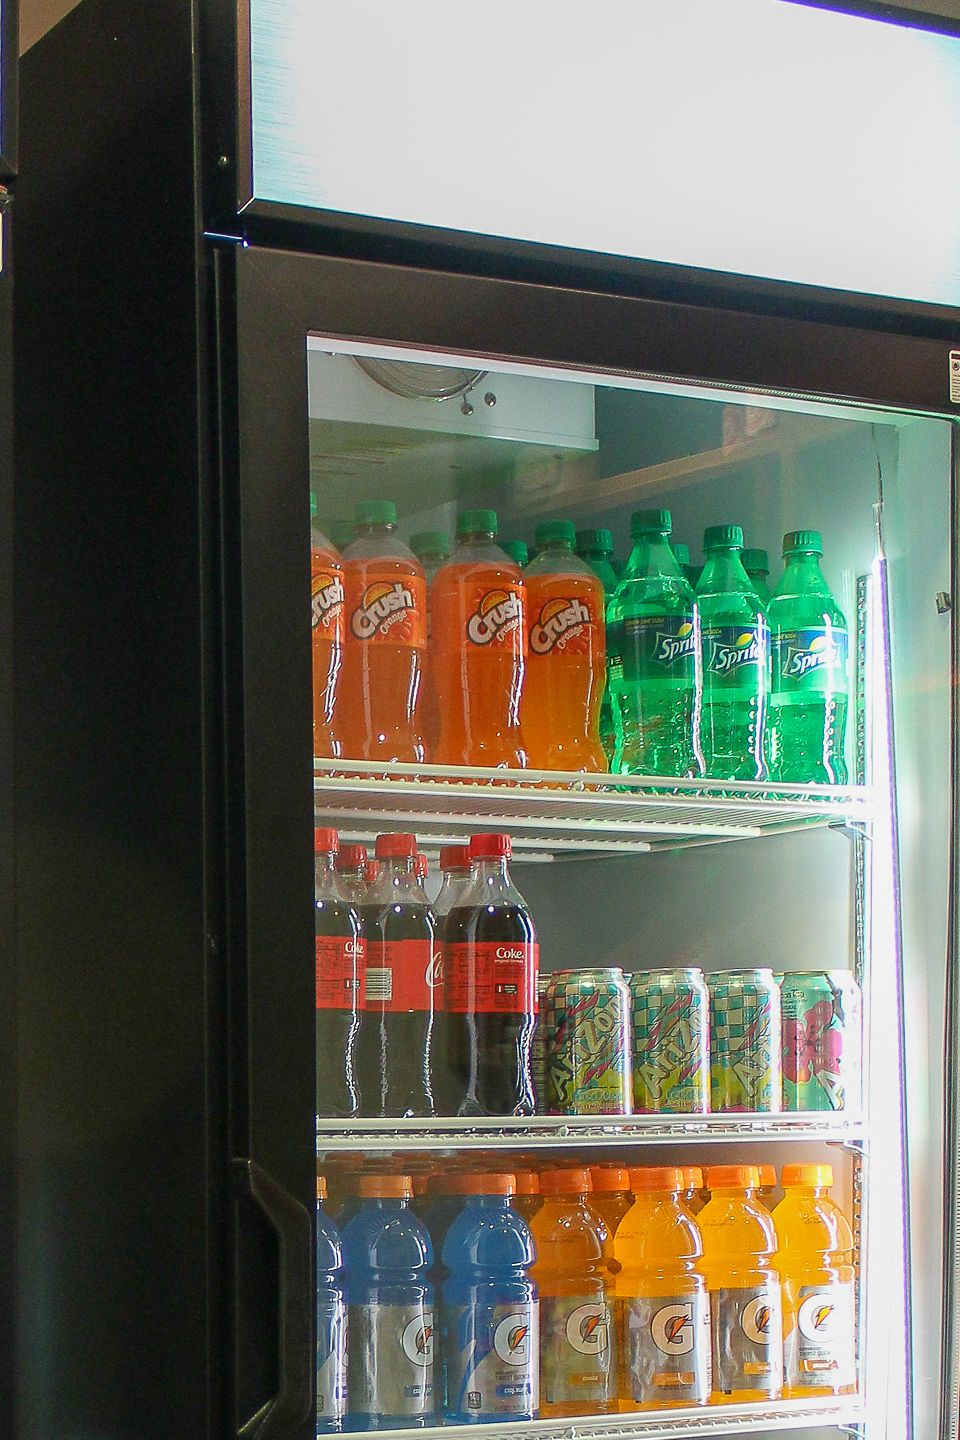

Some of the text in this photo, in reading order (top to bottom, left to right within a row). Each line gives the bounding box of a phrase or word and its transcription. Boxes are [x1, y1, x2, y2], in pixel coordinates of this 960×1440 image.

[312, 577, 344, 627] rush
[351, 583, 413, 639] Crush
[380, 609, 408, 635] Orange
[468, 591, 522, 645] Crush
[530, 599, 590, 655] Crush
[557, 623, 584, 650] Orange
[496, 947, 524, 959] Coke
[566, 1303, 610, 1355] G
[651, 1303, 695, 1356] G
